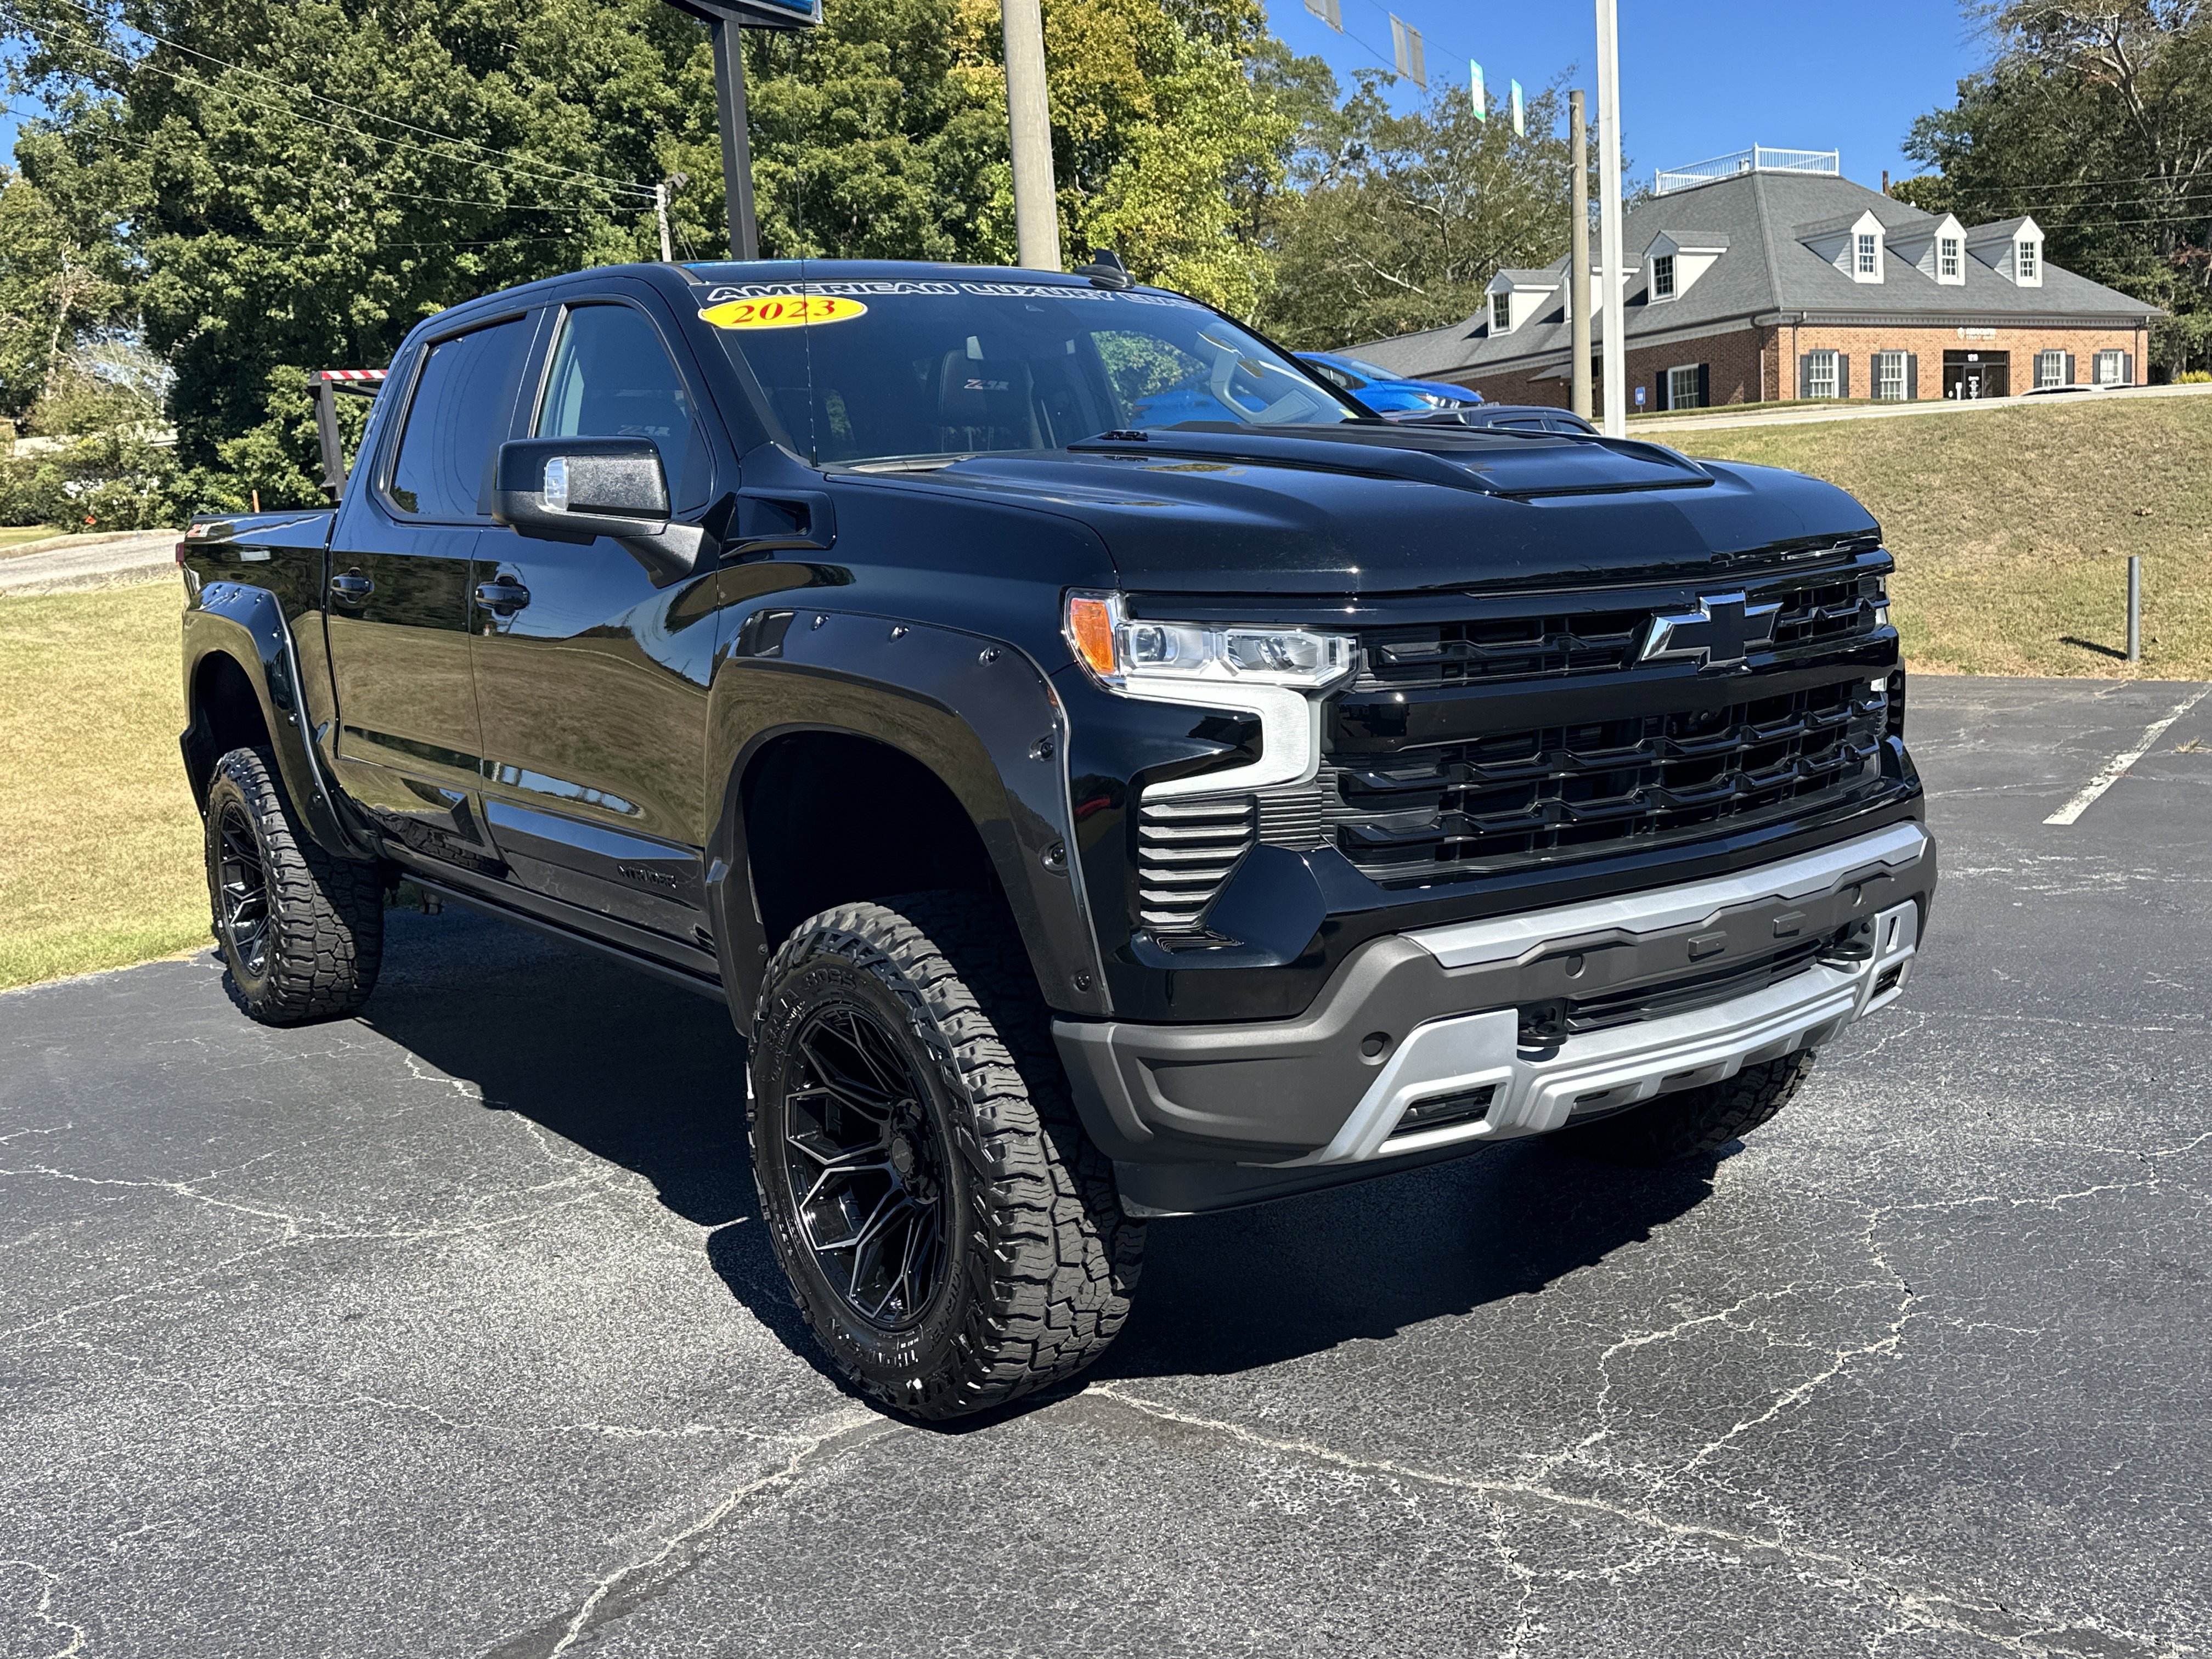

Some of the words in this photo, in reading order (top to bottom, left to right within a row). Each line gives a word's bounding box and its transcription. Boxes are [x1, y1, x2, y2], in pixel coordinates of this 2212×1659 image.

[708, 282, 960, 302] AMERICAN
[960, 284, 1115, 301] LUXURY
[731, 300, 836, 324] 2023
